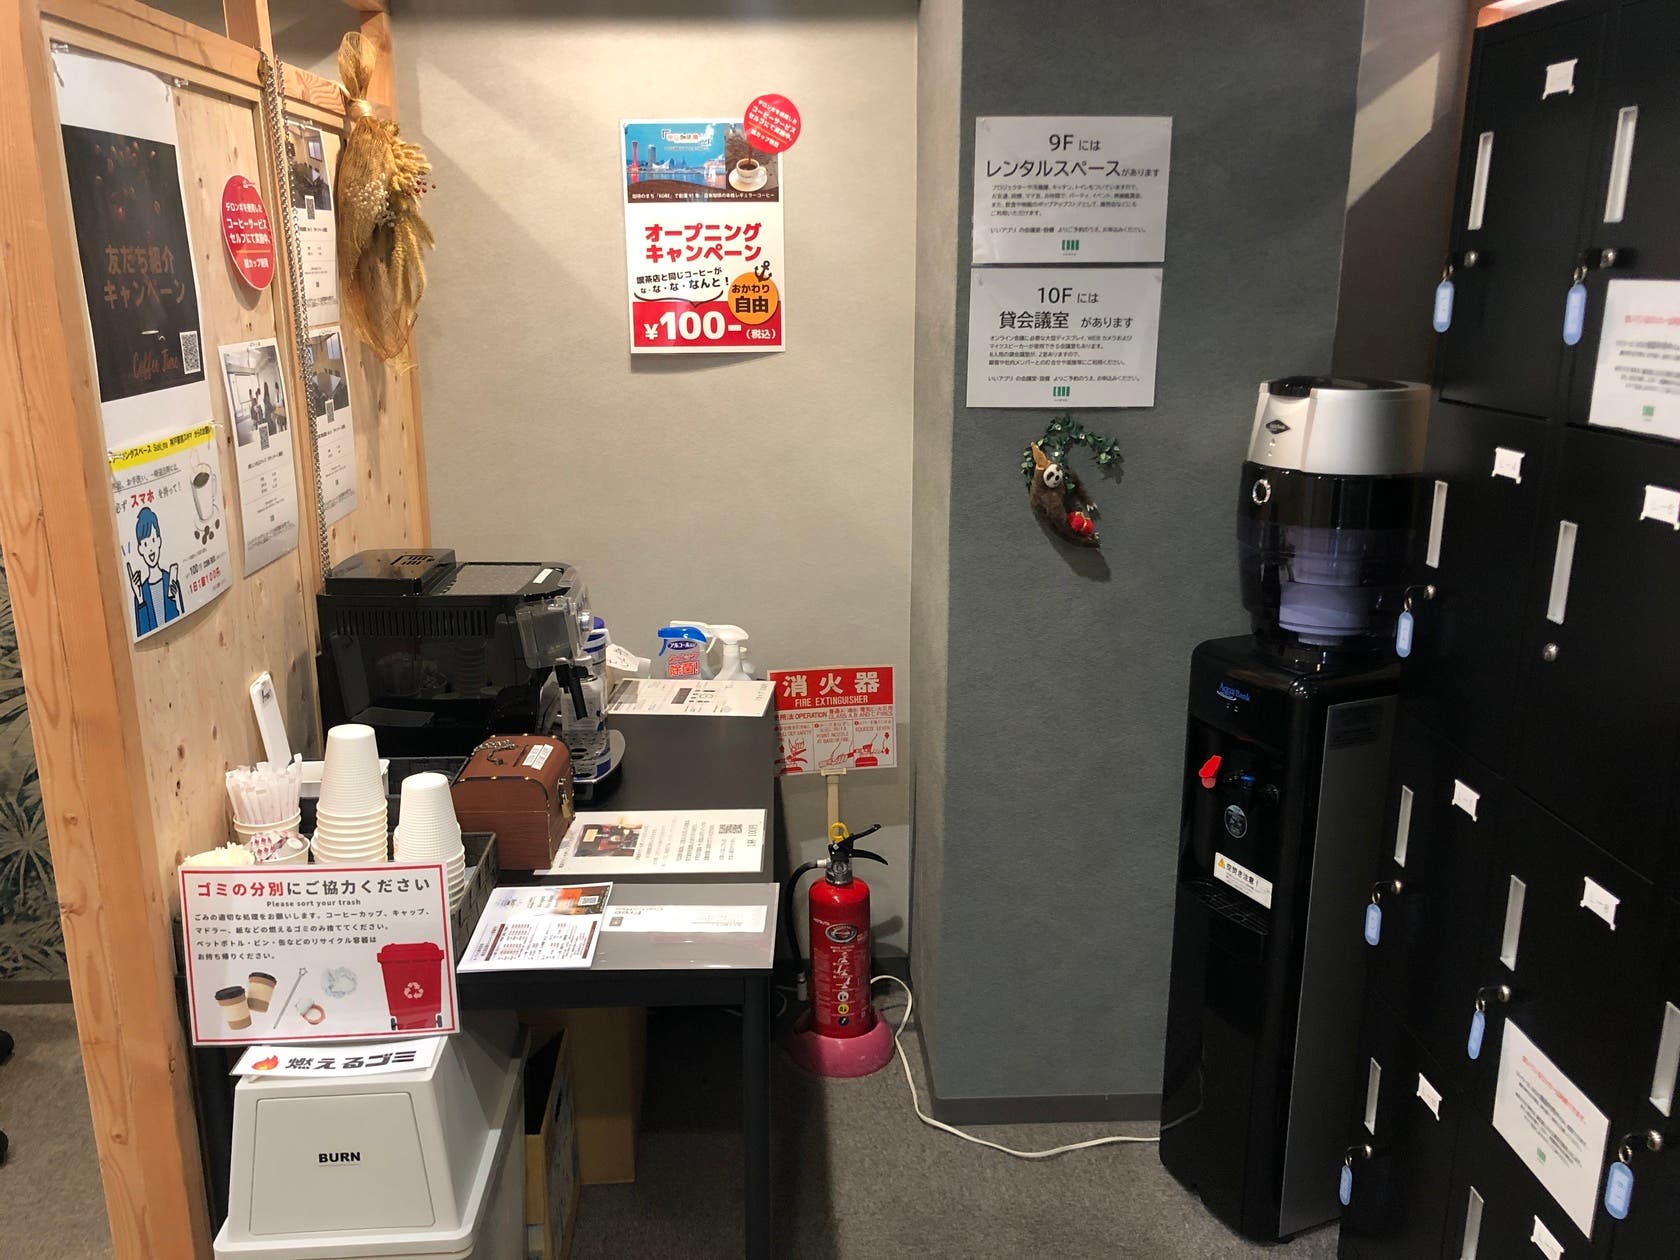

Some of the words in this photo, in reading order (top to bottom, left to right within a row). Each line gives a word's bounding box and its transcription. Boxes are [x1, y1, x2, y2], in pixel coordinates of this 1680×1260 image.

[751, 105, 796, 133] コーヒーサービス
[1048, 134, 1074, 151] 9F
[1079, 139, 1101, 151] には
[986, 159, 1160, 177] レンタルスペースがあります
[227, 218, 268, 229] コーヒーサービス
[645, 222, 762, 242] オープニング
[104, 243, 175, 275] 友だち紹介
[645, 243, 762, 263] キャンペーン
[636, 266, 723, 285] 喫茶店と同じコーヒーが
[103, 275, 185, 310] キャンペーン
[731, 283, 770, 294] おかわり
[1037, 287, 1073, 304] 10F
[1077, 292, 1099, 304] には
[735, 295, 769, 313] 自由
[999, 311, 1070, 329] 貸会議室
[1080, 317, 1134, 328] があります
[130, 489, 155, 509] スマホ
[782, 671, 880, 698] 消火器
[794, 698, 811, 707] FIRE
[815, 695, 868, 706] EXTINGUISHER
[197, 878, 430, 898] ゴミの分別にご協力ください
[266, 900, 295, 908] Please
[316, 899, 336, 909] your
[338, 898, 361, 906] trash
[285, 1050, 417, 1069] 燃えるゴミ
[318, 1151, 361, 1163] BURN
